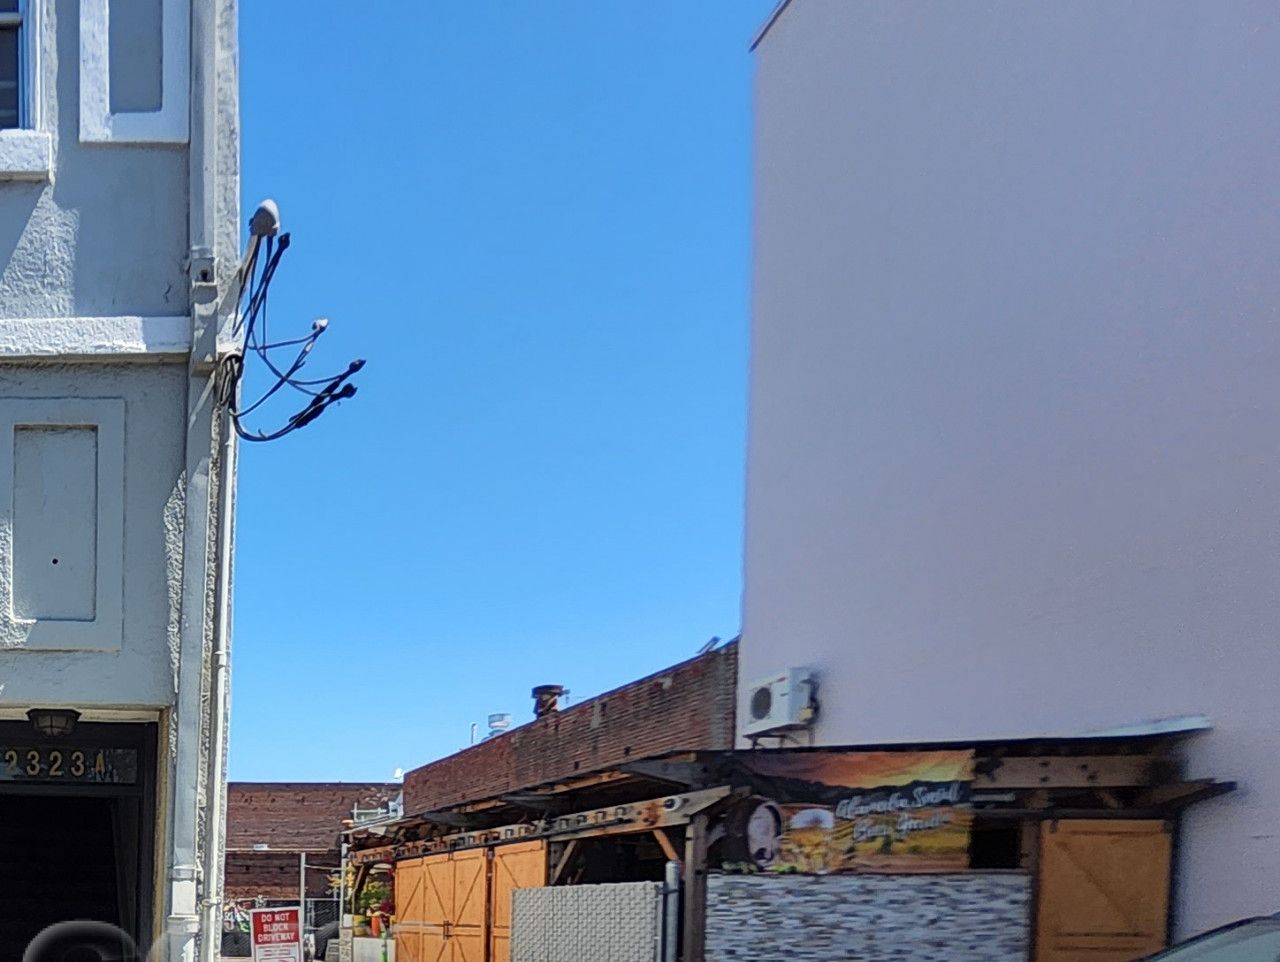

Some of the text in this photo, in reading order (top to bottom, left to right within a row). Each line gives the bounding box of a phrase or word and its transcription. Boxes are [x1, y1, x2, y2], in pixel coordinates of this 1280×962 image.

[261, 913, 290, 922] DO NOT
[263, 923, 289, 932] BLOCK
[257, 932, 295, 943] DRIVEWAY
